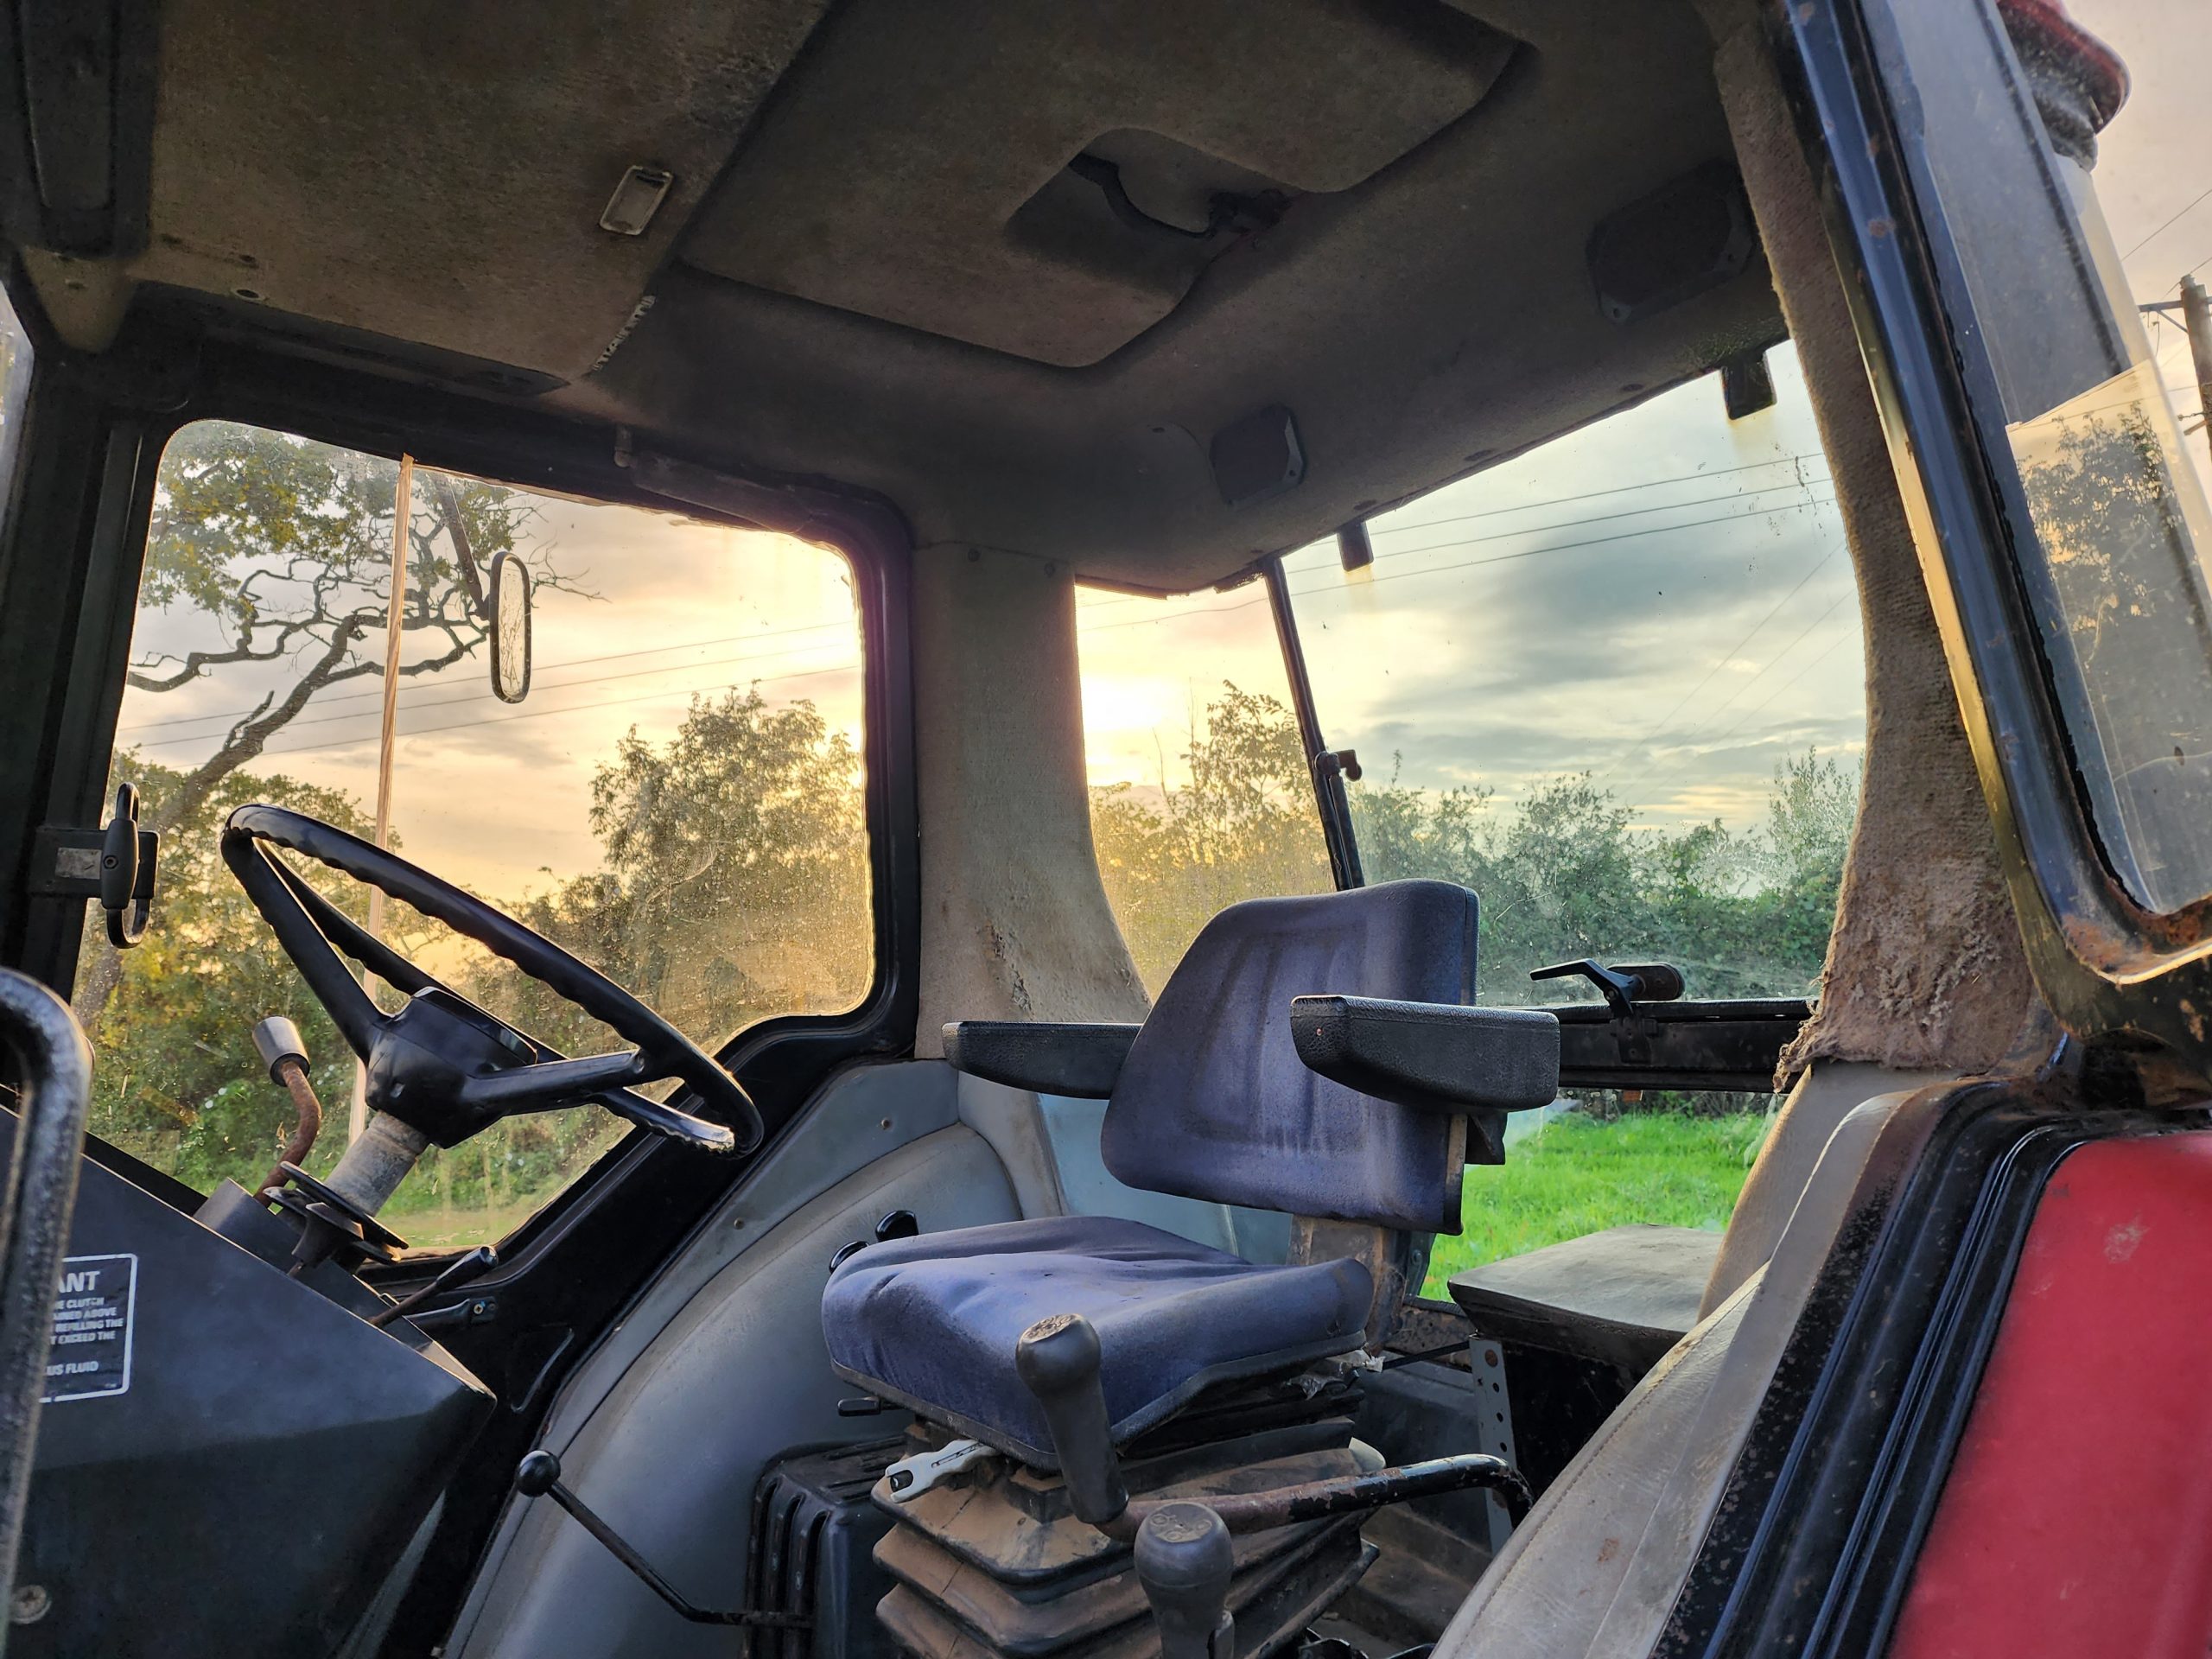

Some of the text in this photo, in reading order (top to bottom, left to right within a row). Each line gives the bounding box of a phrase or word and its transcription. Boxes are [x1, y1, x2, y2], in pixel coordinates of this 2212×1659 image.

[67, 1297, 105, 1309] CLUTCH
[84, 1307, 118, 1319] ABOVE
[55, 1318, 124, 1332] REFILLING THE
[58, 1332, 96, 1344] EXCEED
[97, 1331, 116, 1340] THE
[66, 1361, 99, 1374] FLUID
